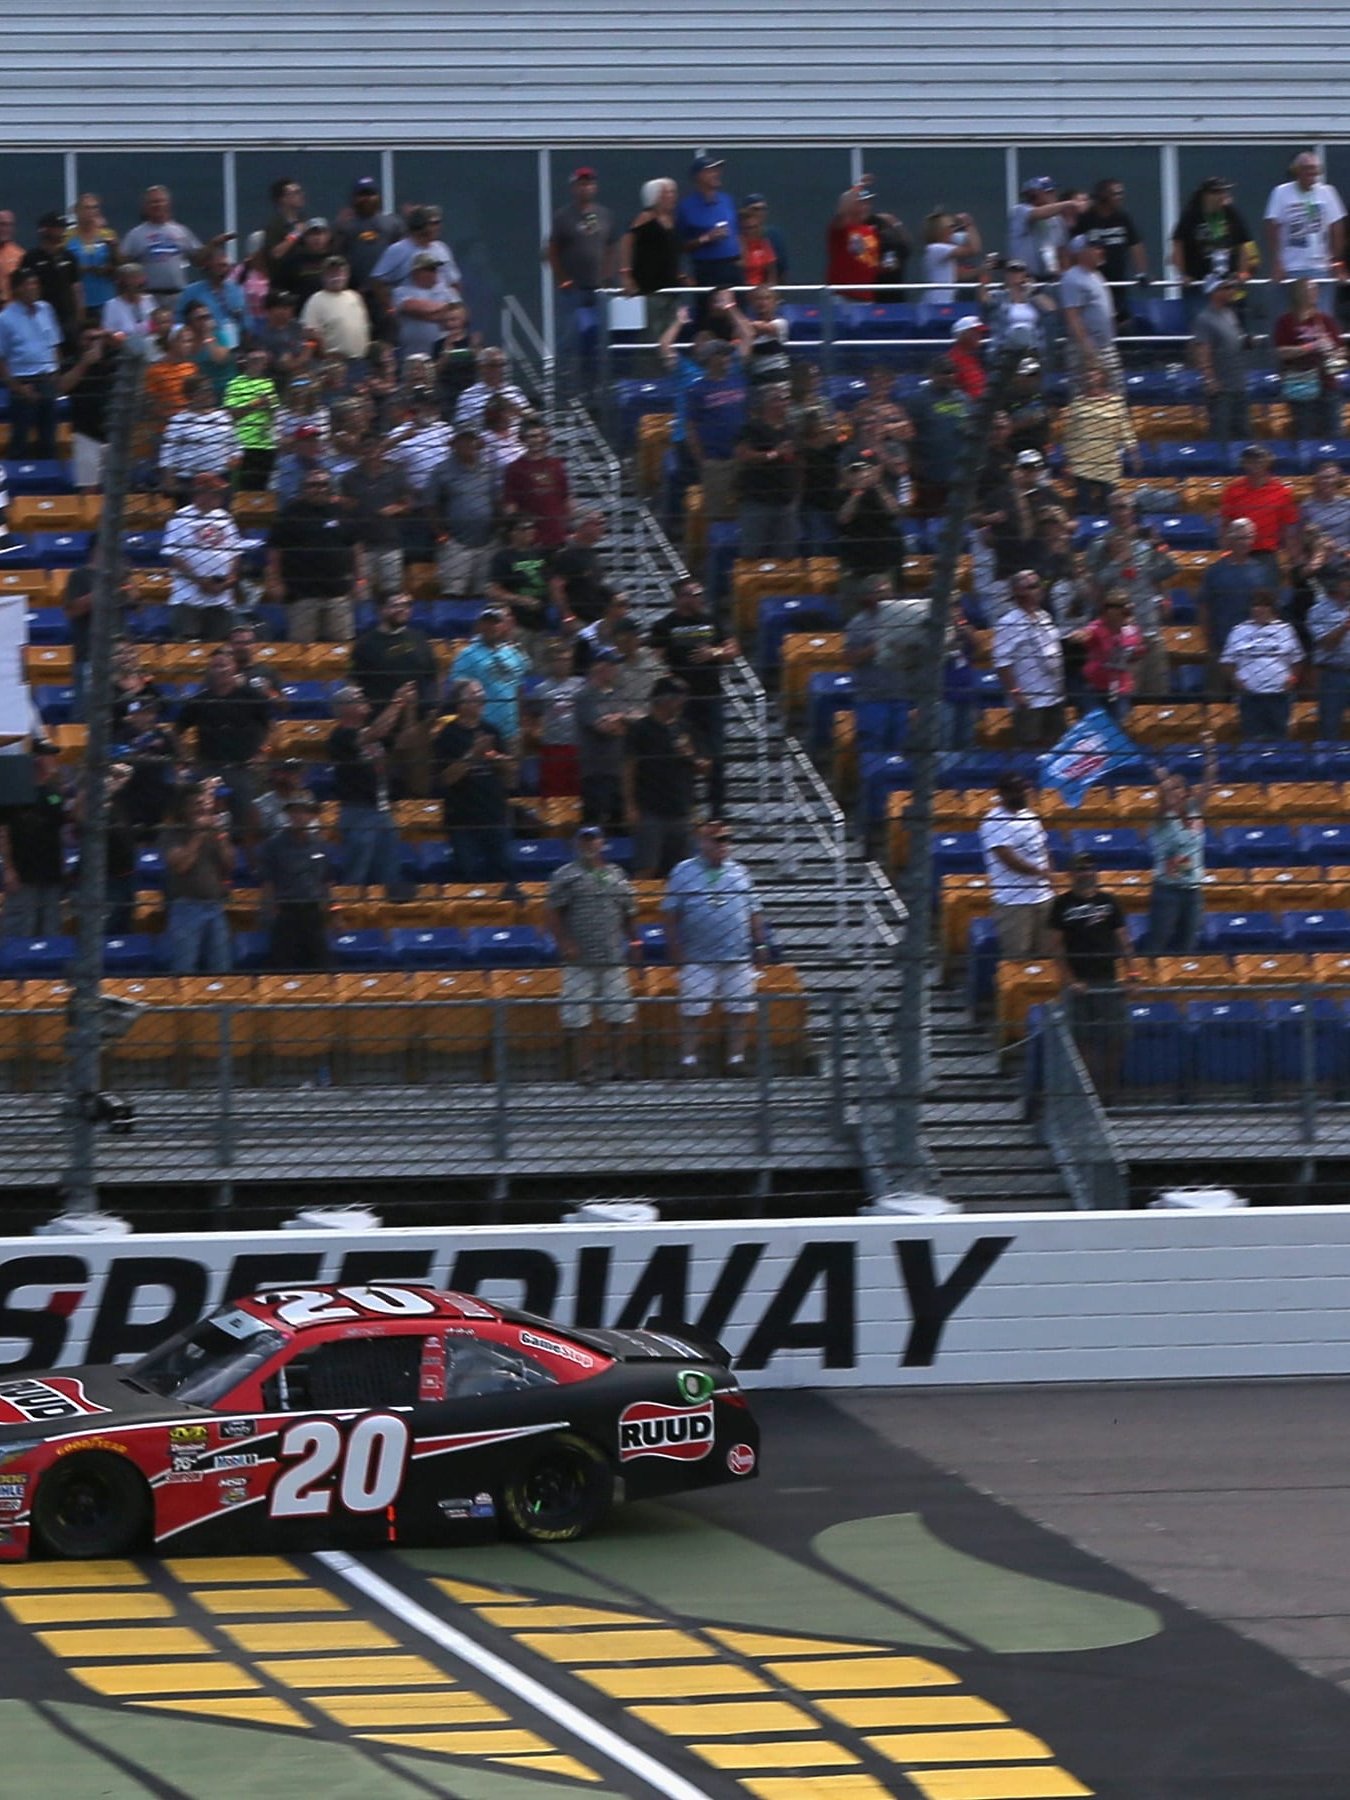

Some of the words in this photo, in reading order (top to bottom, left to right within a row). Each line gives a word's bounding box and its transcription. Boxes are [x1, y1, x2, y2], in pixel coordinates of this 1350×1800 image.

[254, 1283, 439, 1328] 20
[519, 1331, 595, 1368] GameStop
[621, 1415, 713, 1449] RUUD
[269, 1411, 409, 1520] 20
